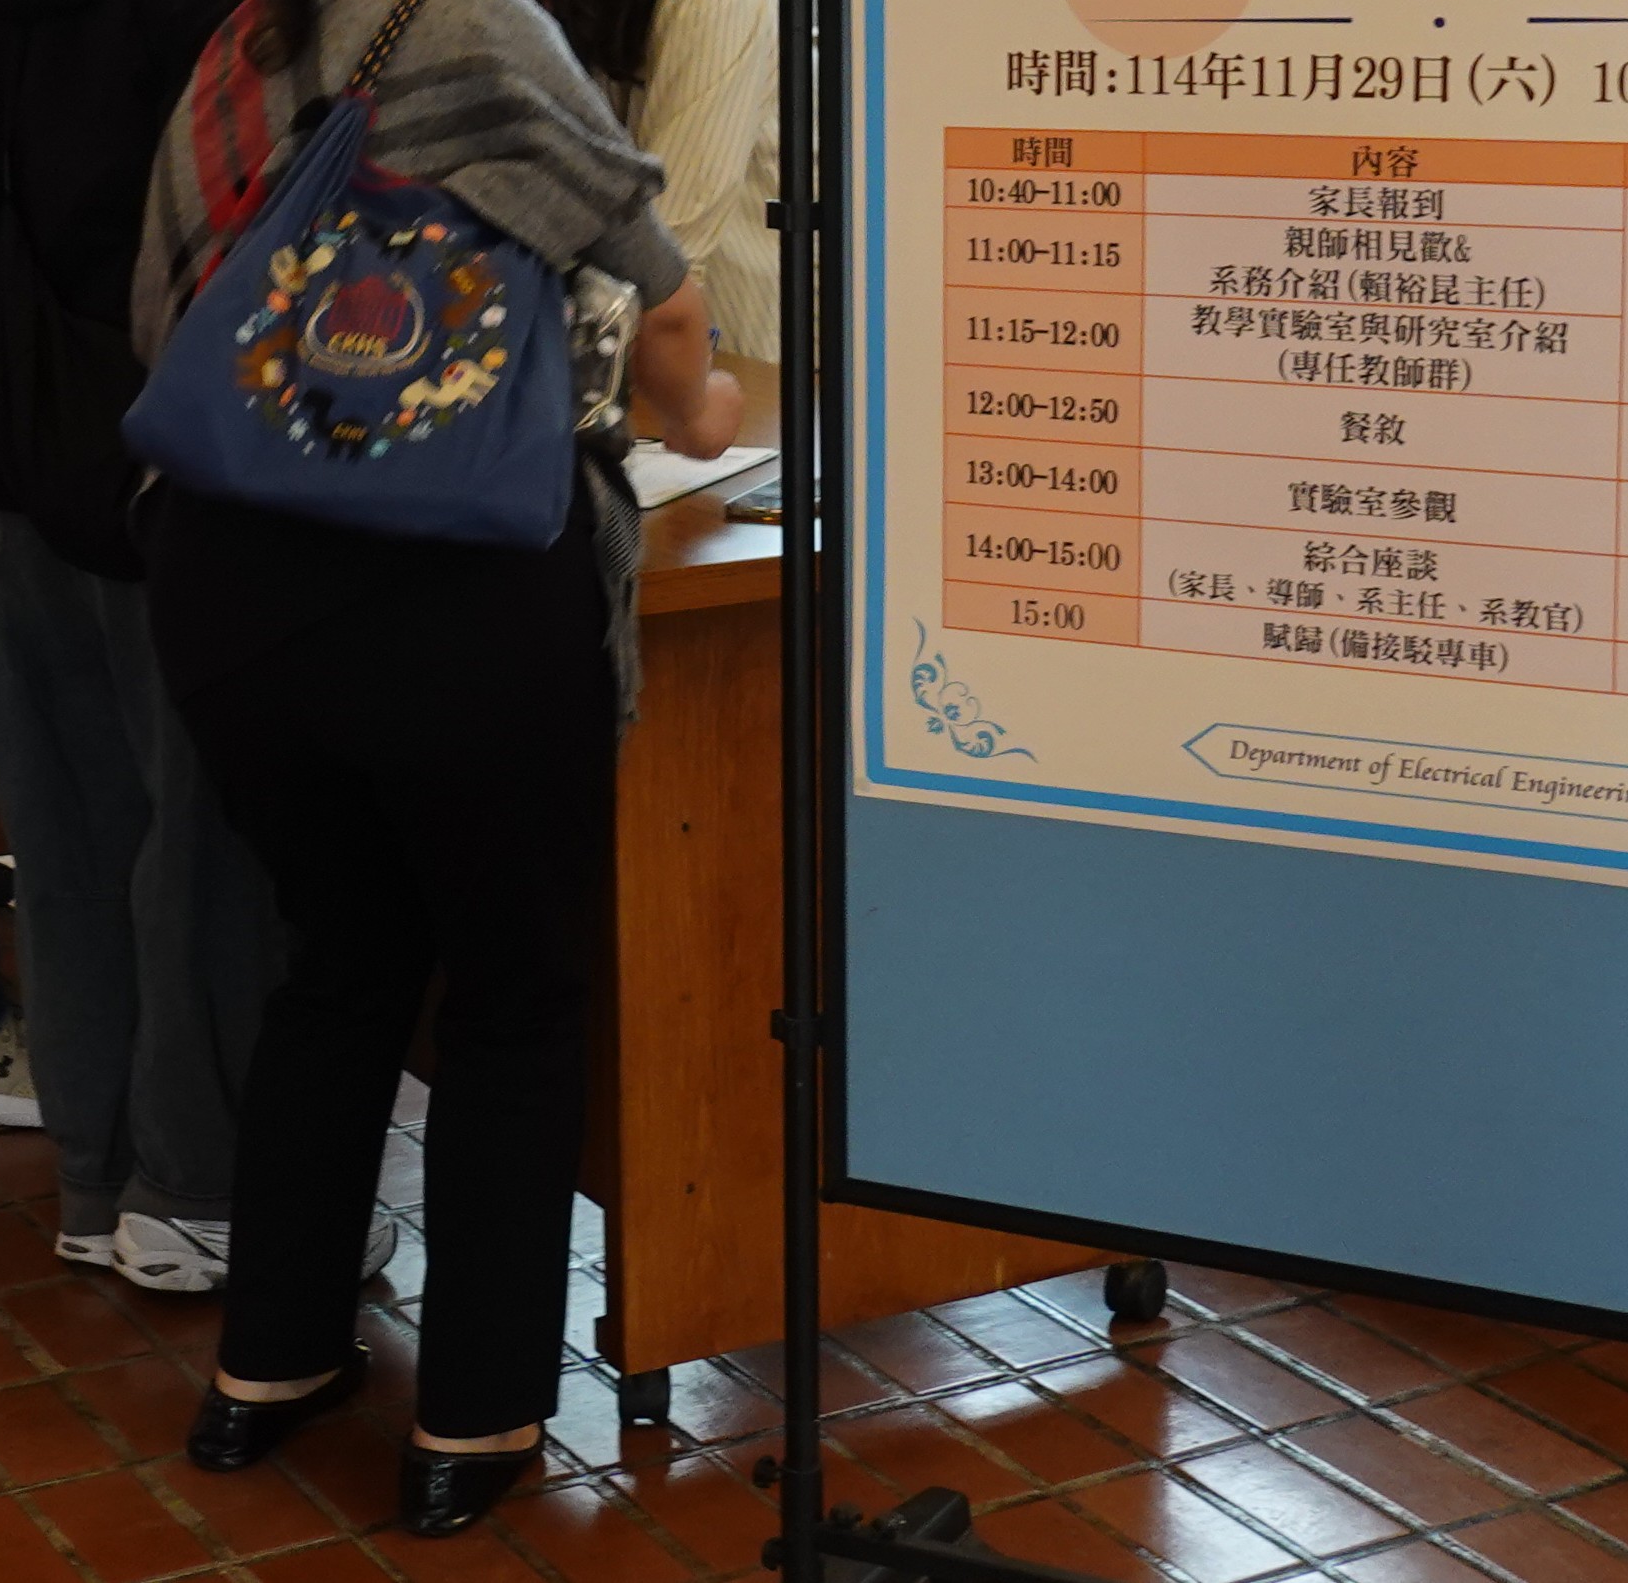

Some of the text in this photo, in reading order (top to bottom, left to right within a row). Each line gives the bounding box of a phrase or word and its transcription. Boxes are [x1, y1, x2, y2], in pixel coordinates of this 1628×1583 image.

[1011, 136, 1075, 168] 時間
[1351, 144, 1421, 178] 內容
[967, 177, 1122, 208] 10:40-11:00
[1307, 184, 1445, 221] 家長報到
[966, 236, 1122, 268] 11:00-11:15
[966, 316, 1120, 349] 11:15-12:00
[1189, 303, 1570, 356] 教學實驗室與研究室介紹
[967, 390, 1120, 425] 12:00-12:50
[966, 459, 1120, 496] 13:00-14:00
[1287, 480, 1458, 525] 實驗室參觀
[966, 532, 1122, 572] 14:00-15:00
[1302, 539, 1440, 584] 綜合座談
[1010, 598, 1086, 632] 15:00
[1229, 739, 1361, 776] Department
[1368, 753, 1395, 785] of
[1398, 757, 1507, 790] Electrical
